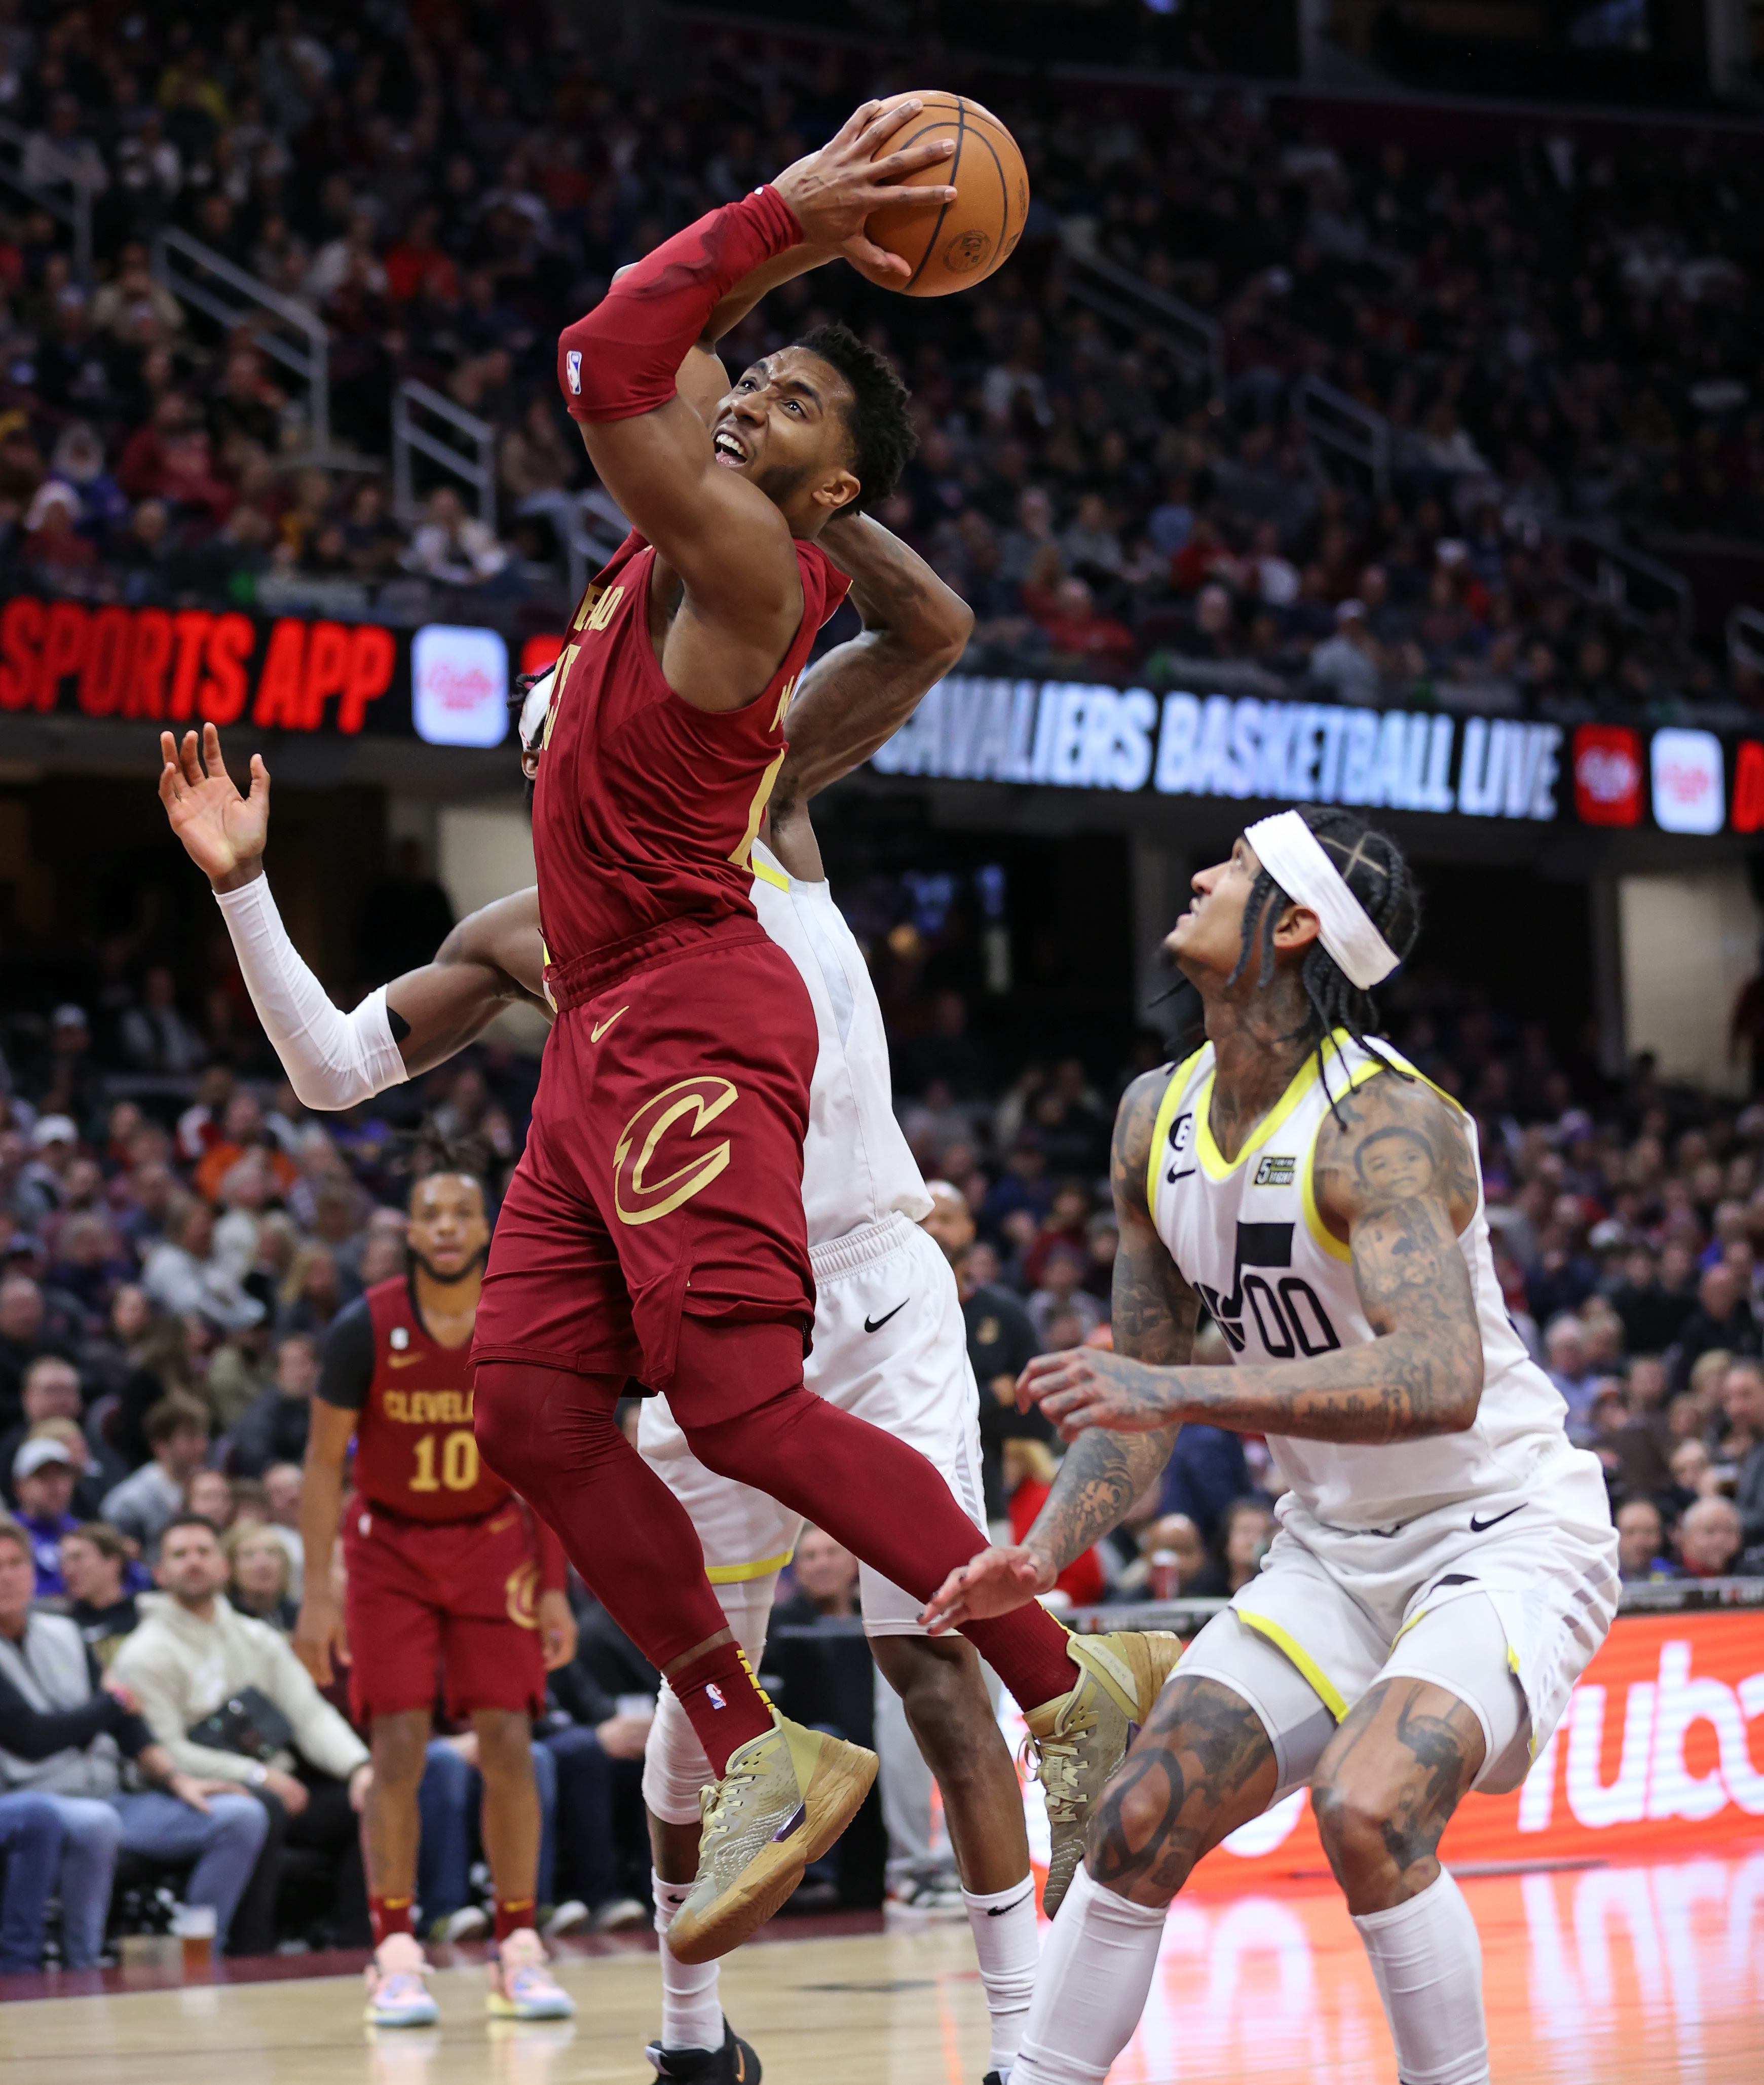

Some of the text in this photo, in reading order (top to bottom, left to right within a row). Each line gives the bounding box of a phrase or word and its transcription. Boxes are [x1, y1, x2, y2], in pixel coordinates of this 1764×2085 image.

[0, 596, 255, 725] SPORTS
[252, 617, 397, 734] APP
[1153, 689, 1454, 813] BASKETBALL
[1457, 714, 1565, 822] LIVE
[1243, 1273, 1341, 1359] 00
[409, 1429, 479, 1493] 10
